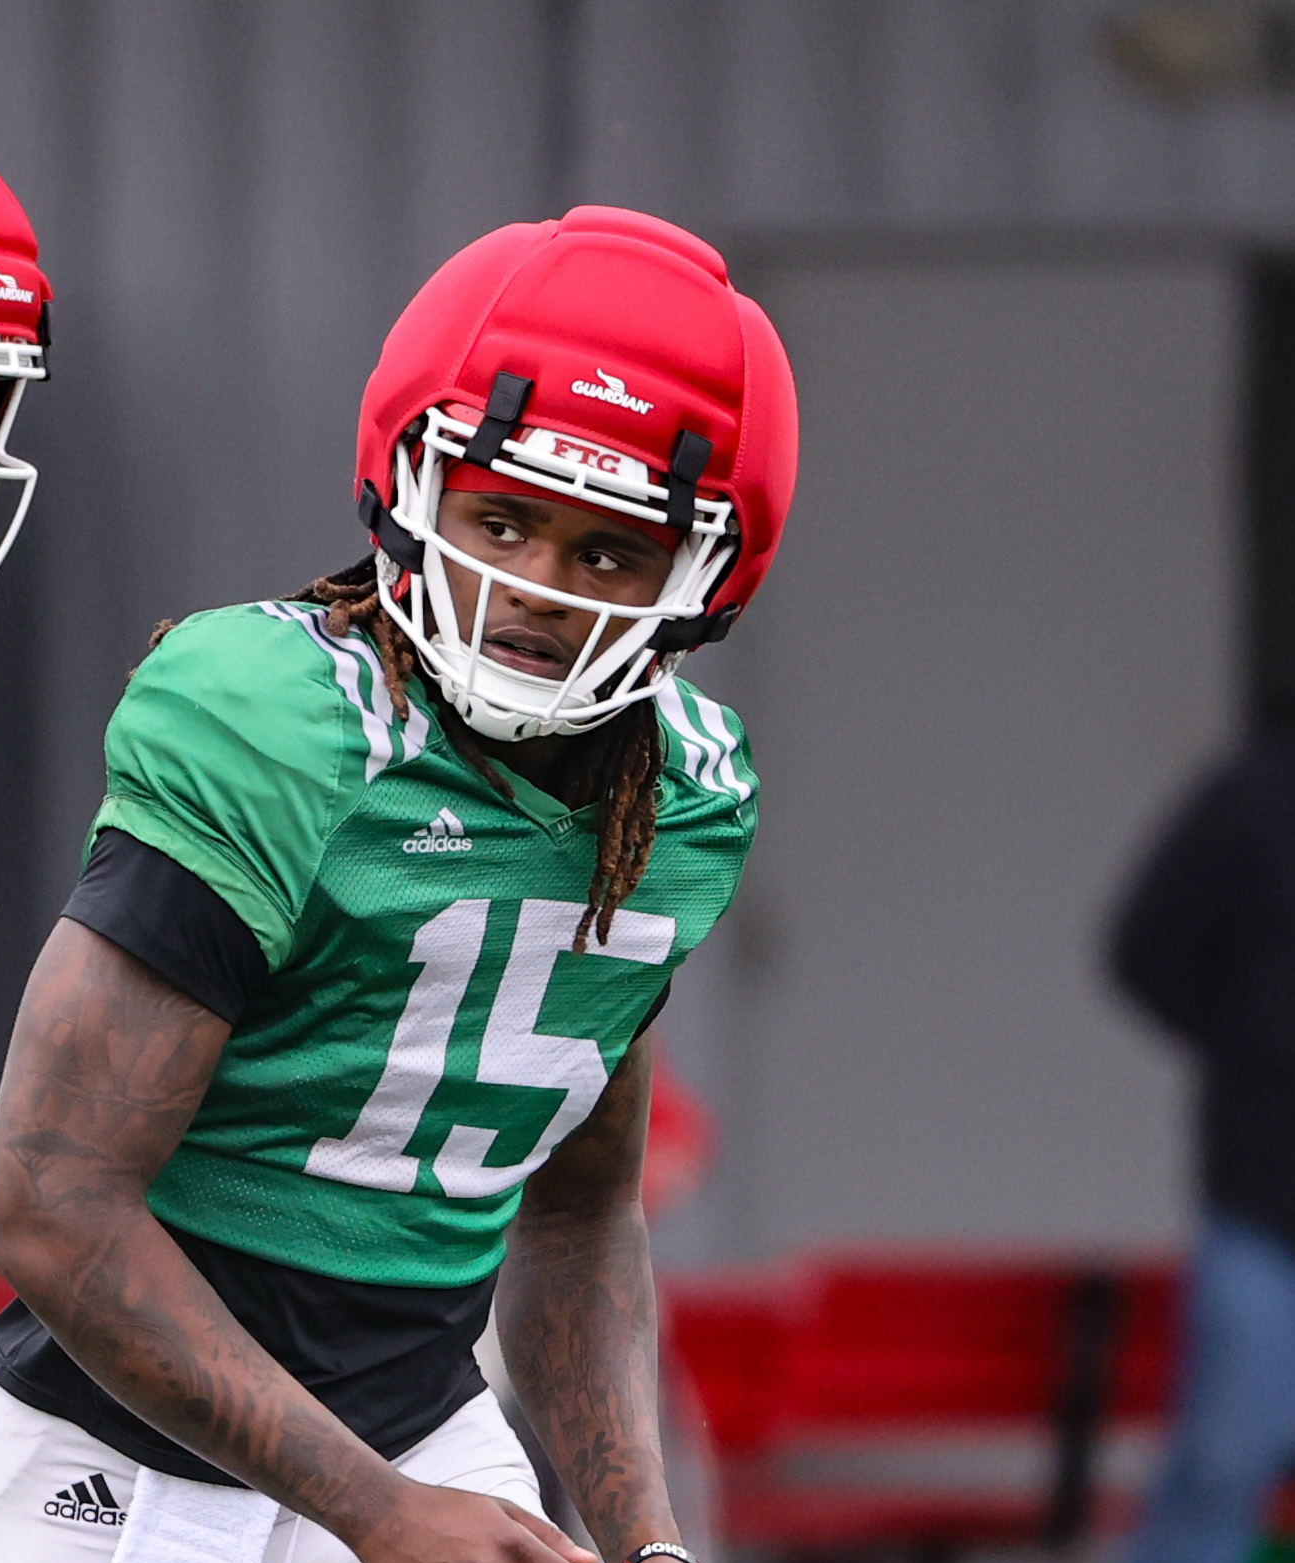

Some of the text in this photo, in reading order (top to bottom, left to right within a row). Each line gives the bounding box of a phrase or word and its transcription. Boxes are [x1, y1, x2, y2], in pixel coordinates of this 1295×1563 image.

[571, 380, 650, 414] GUARDIAN
[551, 437, 621, 475] FTC
[402, 833, 473, 853] adidas
[302, 898, 676, 1198] 15
[44, 1500, 128, 1526] adidas
[639, 1542, 688, 1559] CHOP
